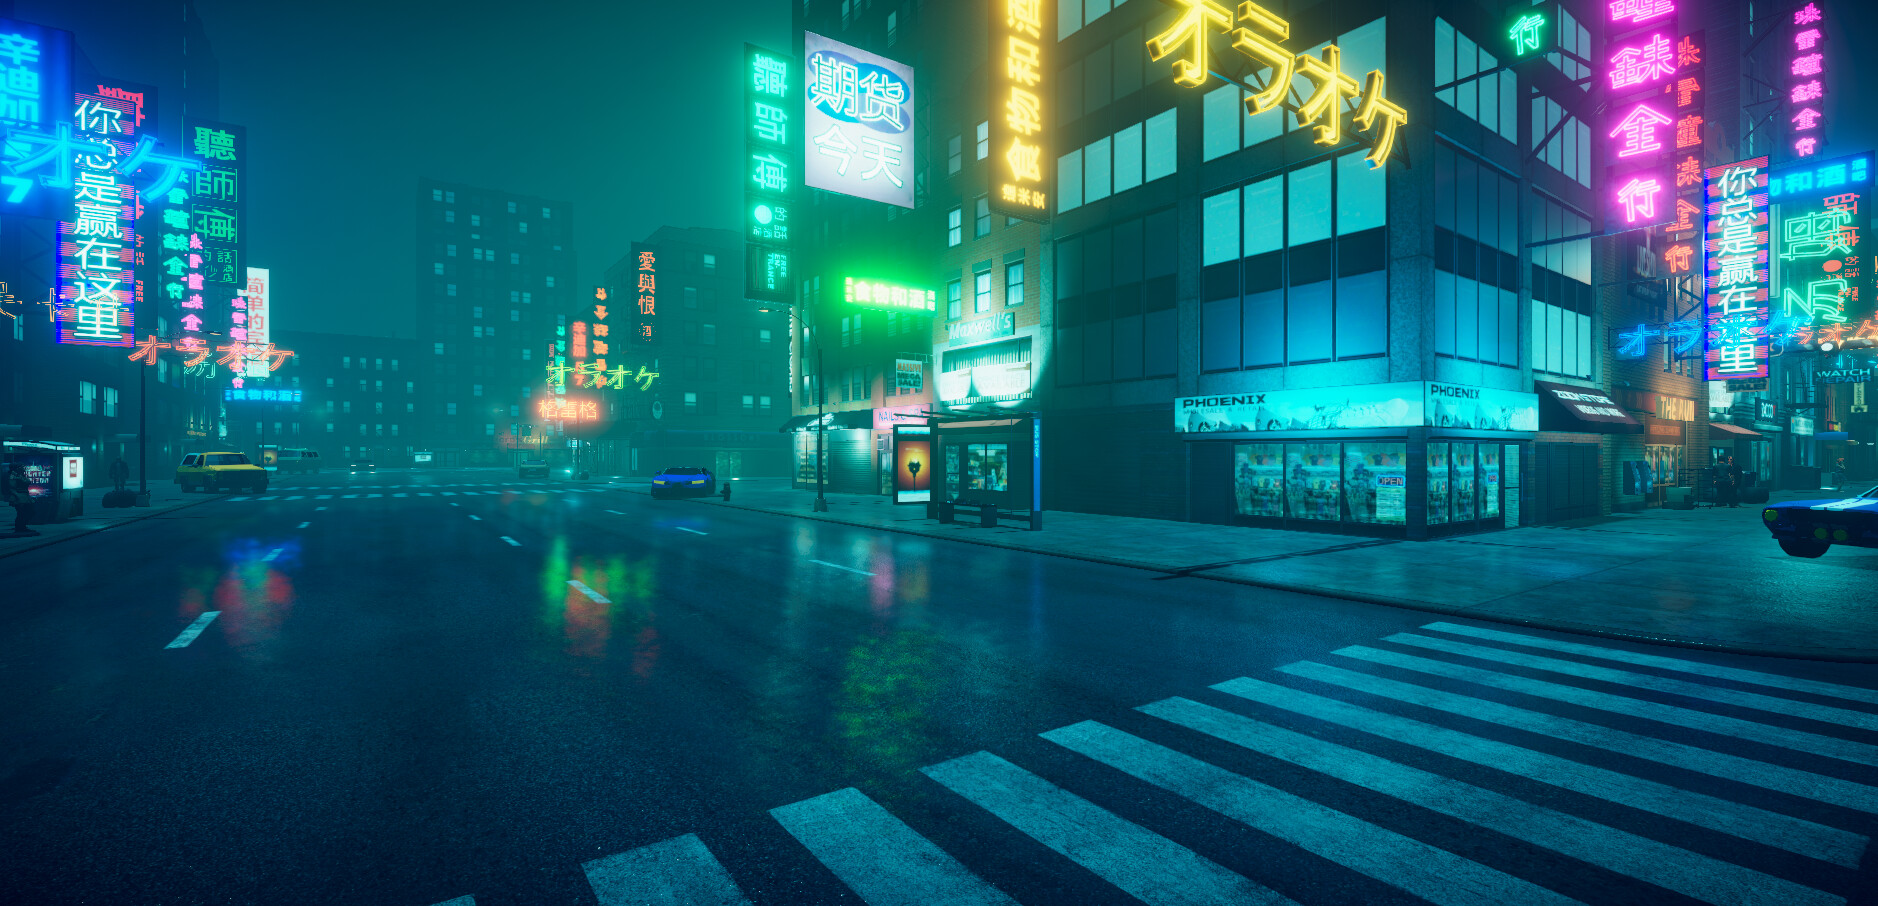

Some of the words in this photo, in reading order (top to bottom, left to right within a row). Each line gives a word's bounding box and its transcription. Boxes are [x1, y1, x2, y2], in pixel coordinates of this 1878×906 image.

[811, 53, 904, 131] 期货
[1146, 0, 1408, 170] オラオケ
[813, 124, 904, 188] 今天
[638, 251, 656, 316] 愛與恨
[949, 311, 1011, 340] Maxwell's
[546, 361, 660, 391] オラオケ
[1816, 368, 1871, 378] WATCH
[1183, 394, 1265, 408] PHOENIX
[1431, 384, 1480, 399] PHOENIX
